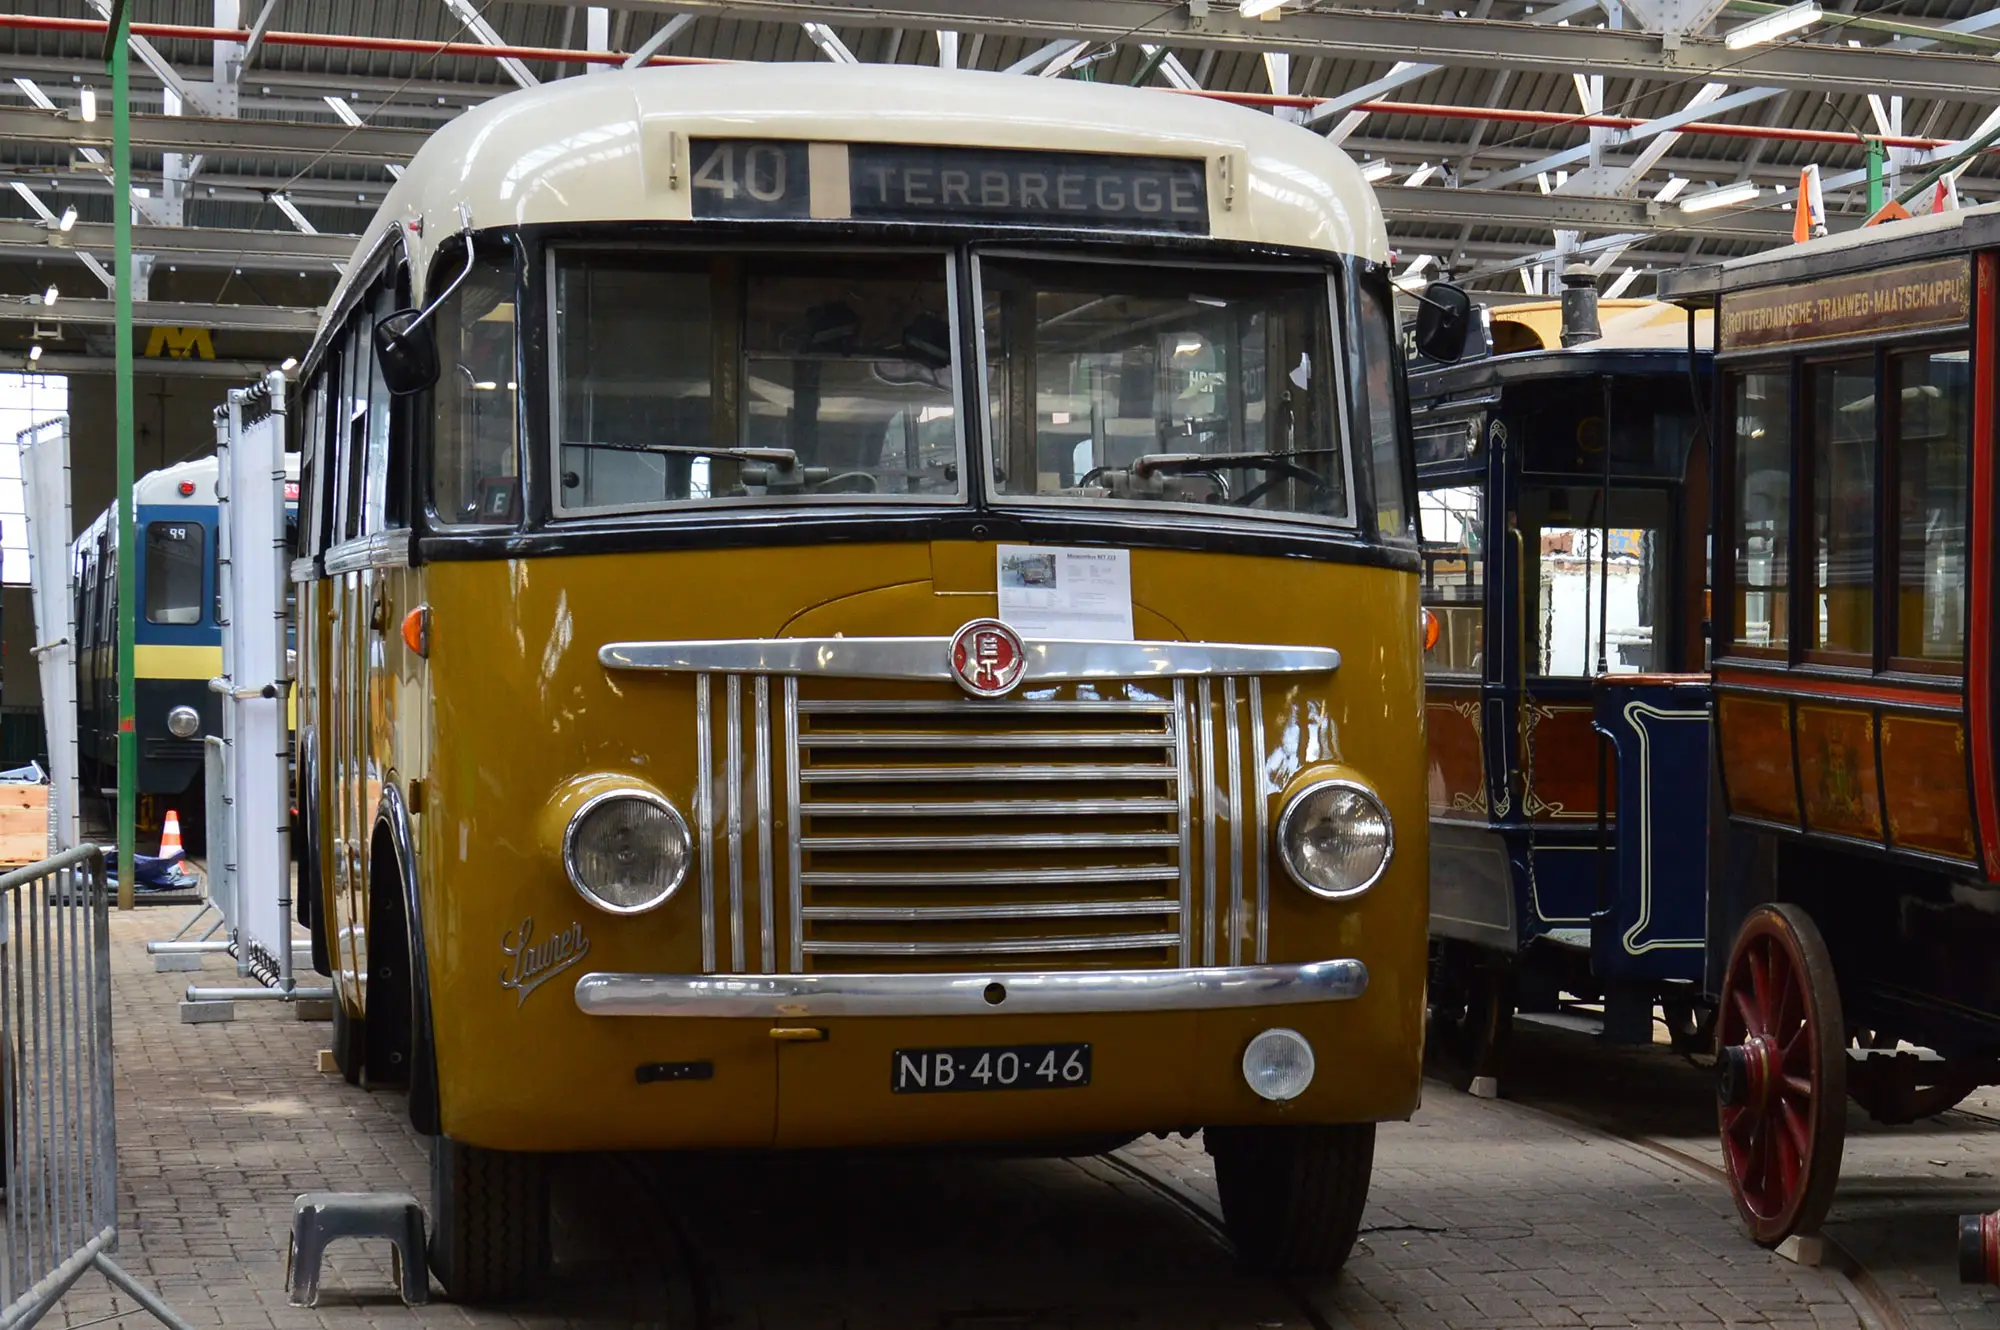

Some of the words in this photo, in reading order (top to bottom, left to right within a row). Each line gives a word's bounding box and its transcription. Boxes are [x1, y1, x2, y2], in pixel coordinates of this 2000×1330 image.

[692, 144, 787, 202] 40
[872, 165, 1199, 214] TERBREGGE
[493, 493, 506, 513] E
